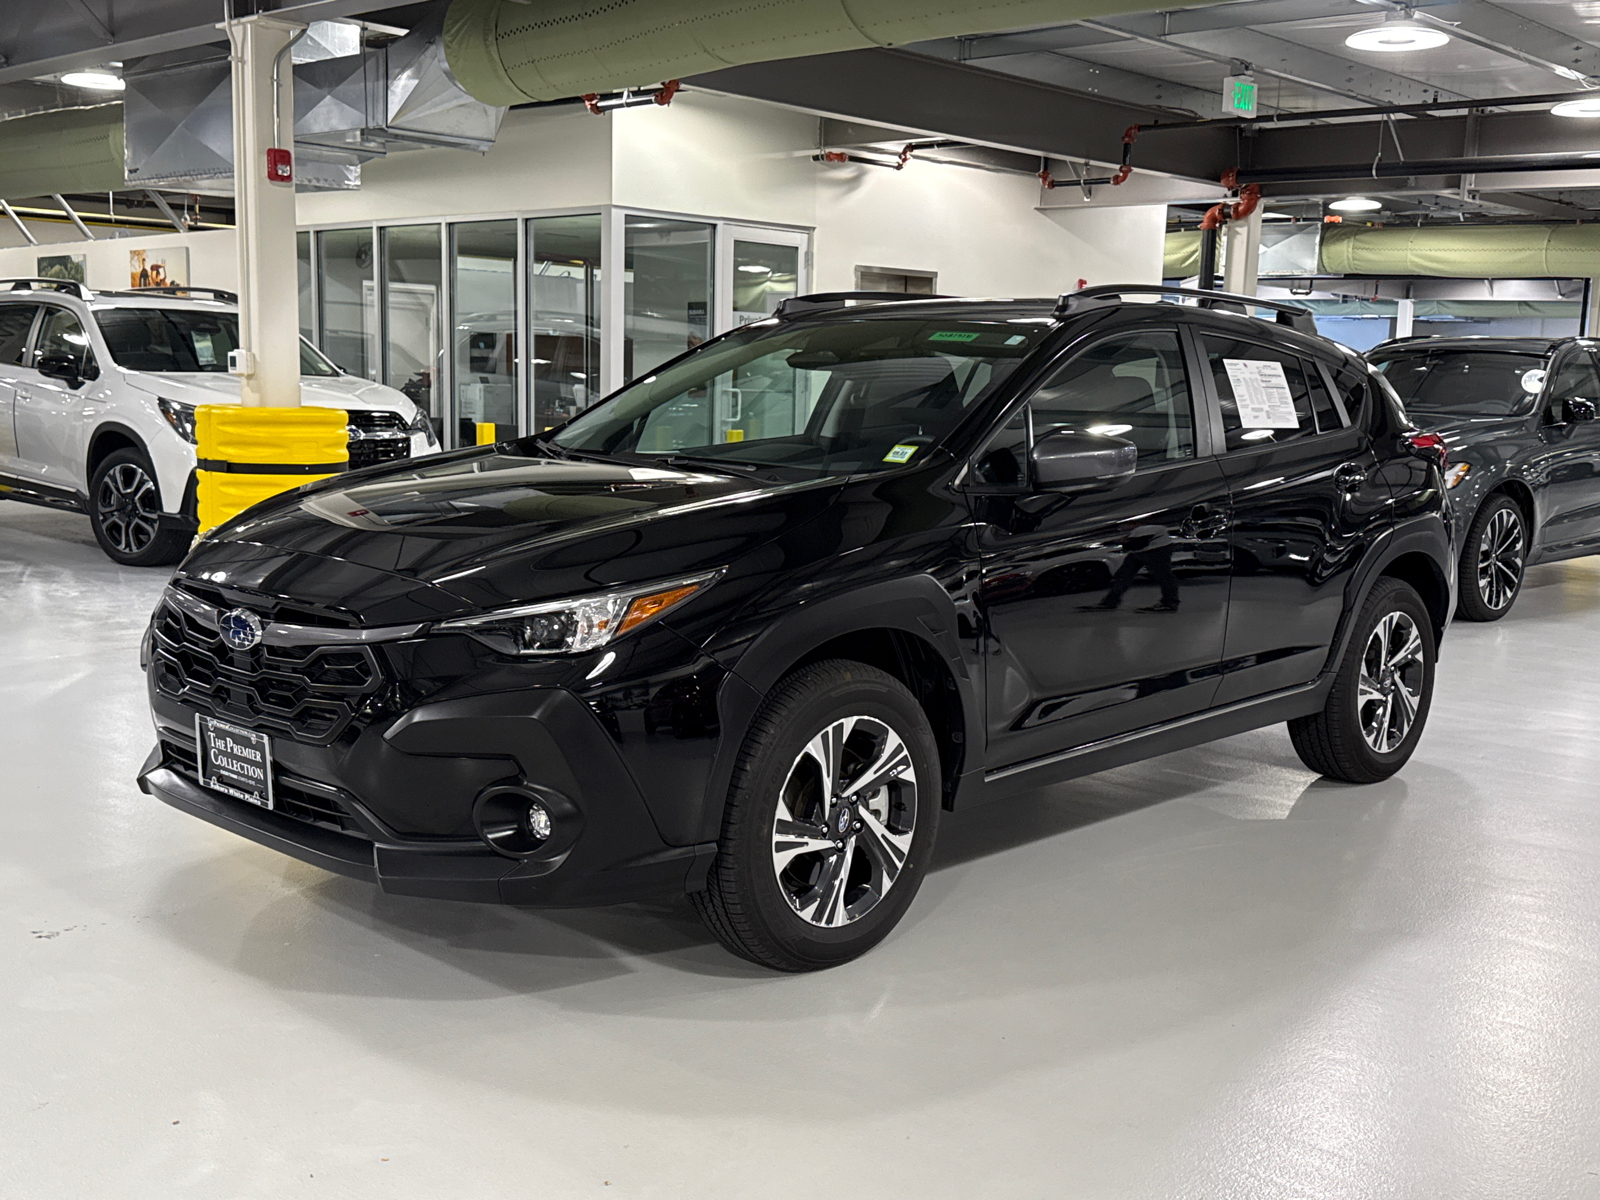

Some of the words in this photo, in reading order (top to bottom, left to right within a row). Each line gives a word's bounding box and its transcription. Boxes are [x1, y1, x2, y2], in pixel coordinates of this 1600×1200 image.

[1234, 82, 1254, 111] EXIT
[739, 315, 762, 325] Priv
[208, 732, 226, 751] THE
[226, 737, 262, 762] PREMIER
[211, 748, 264, 780] COLLECTION
